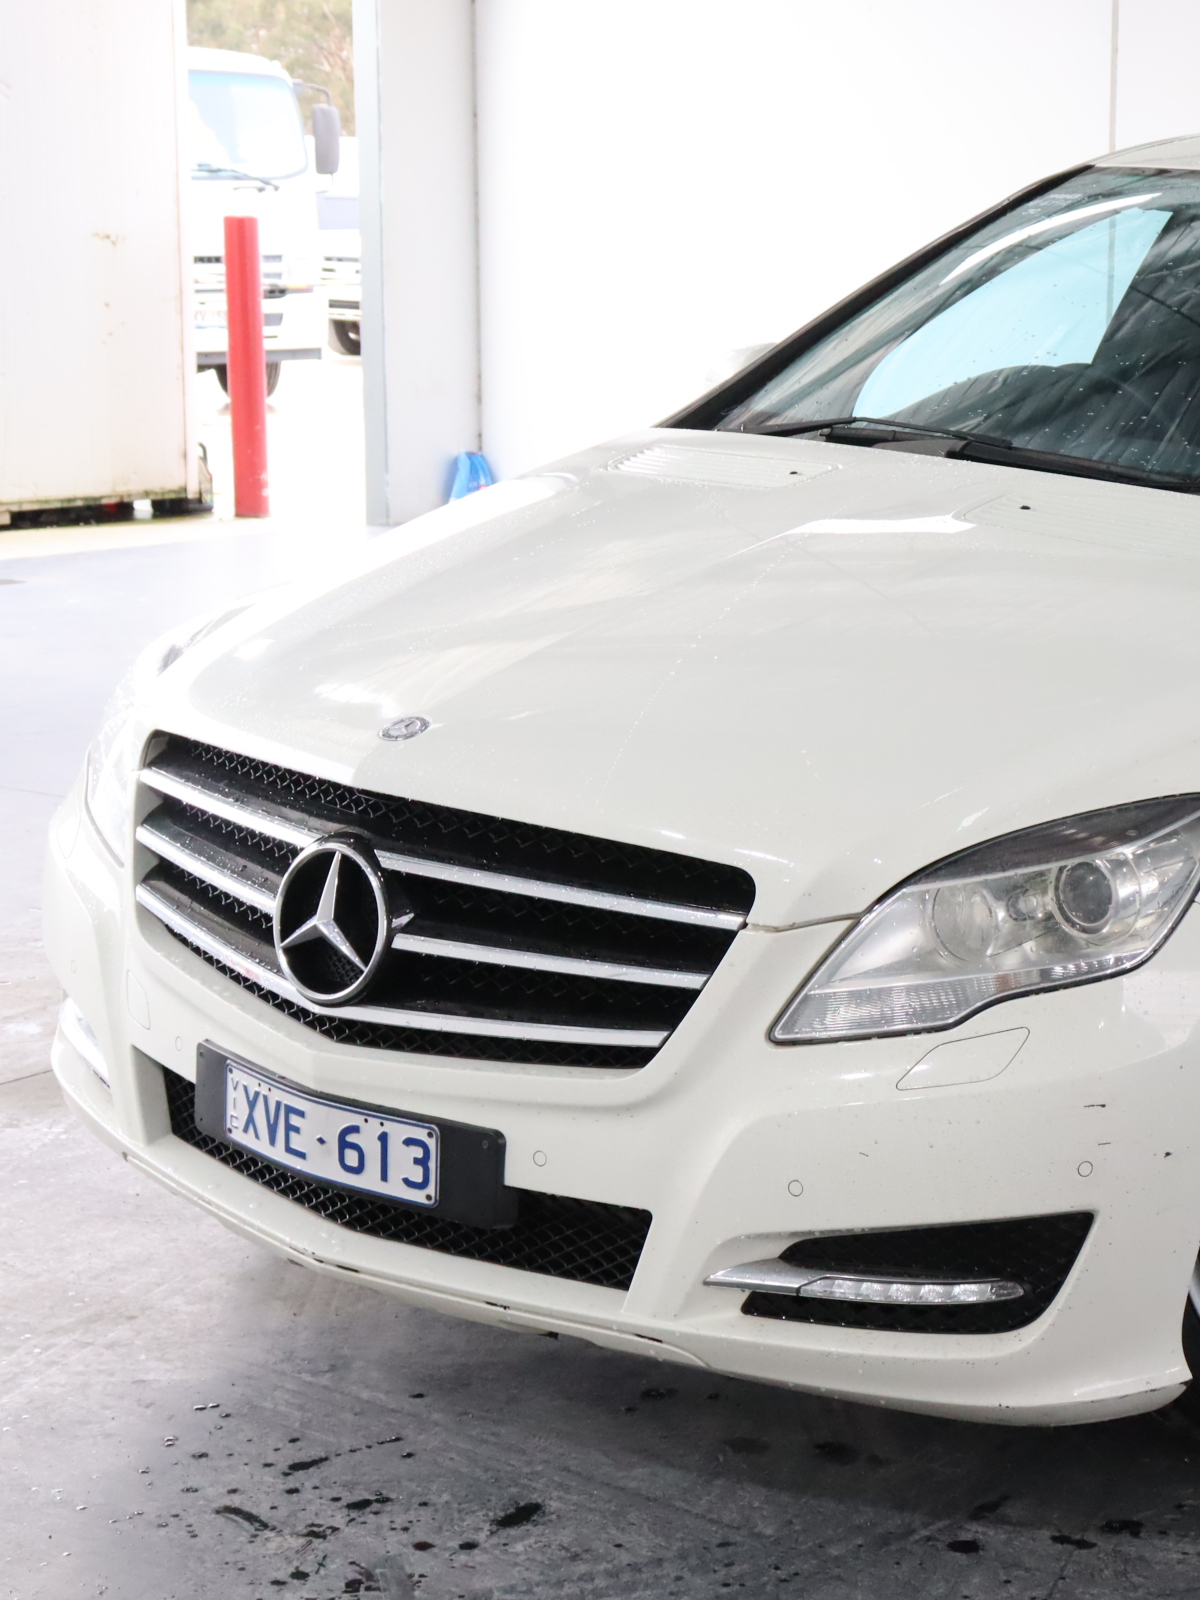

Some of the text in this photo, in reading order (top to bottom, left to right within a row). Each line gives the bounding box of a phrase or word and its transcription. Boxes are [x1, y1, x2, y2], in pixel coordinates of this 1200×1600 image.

[229, 1076, 240, 1130] VIC
[242, 1082, 430, 1190] XVE 613
